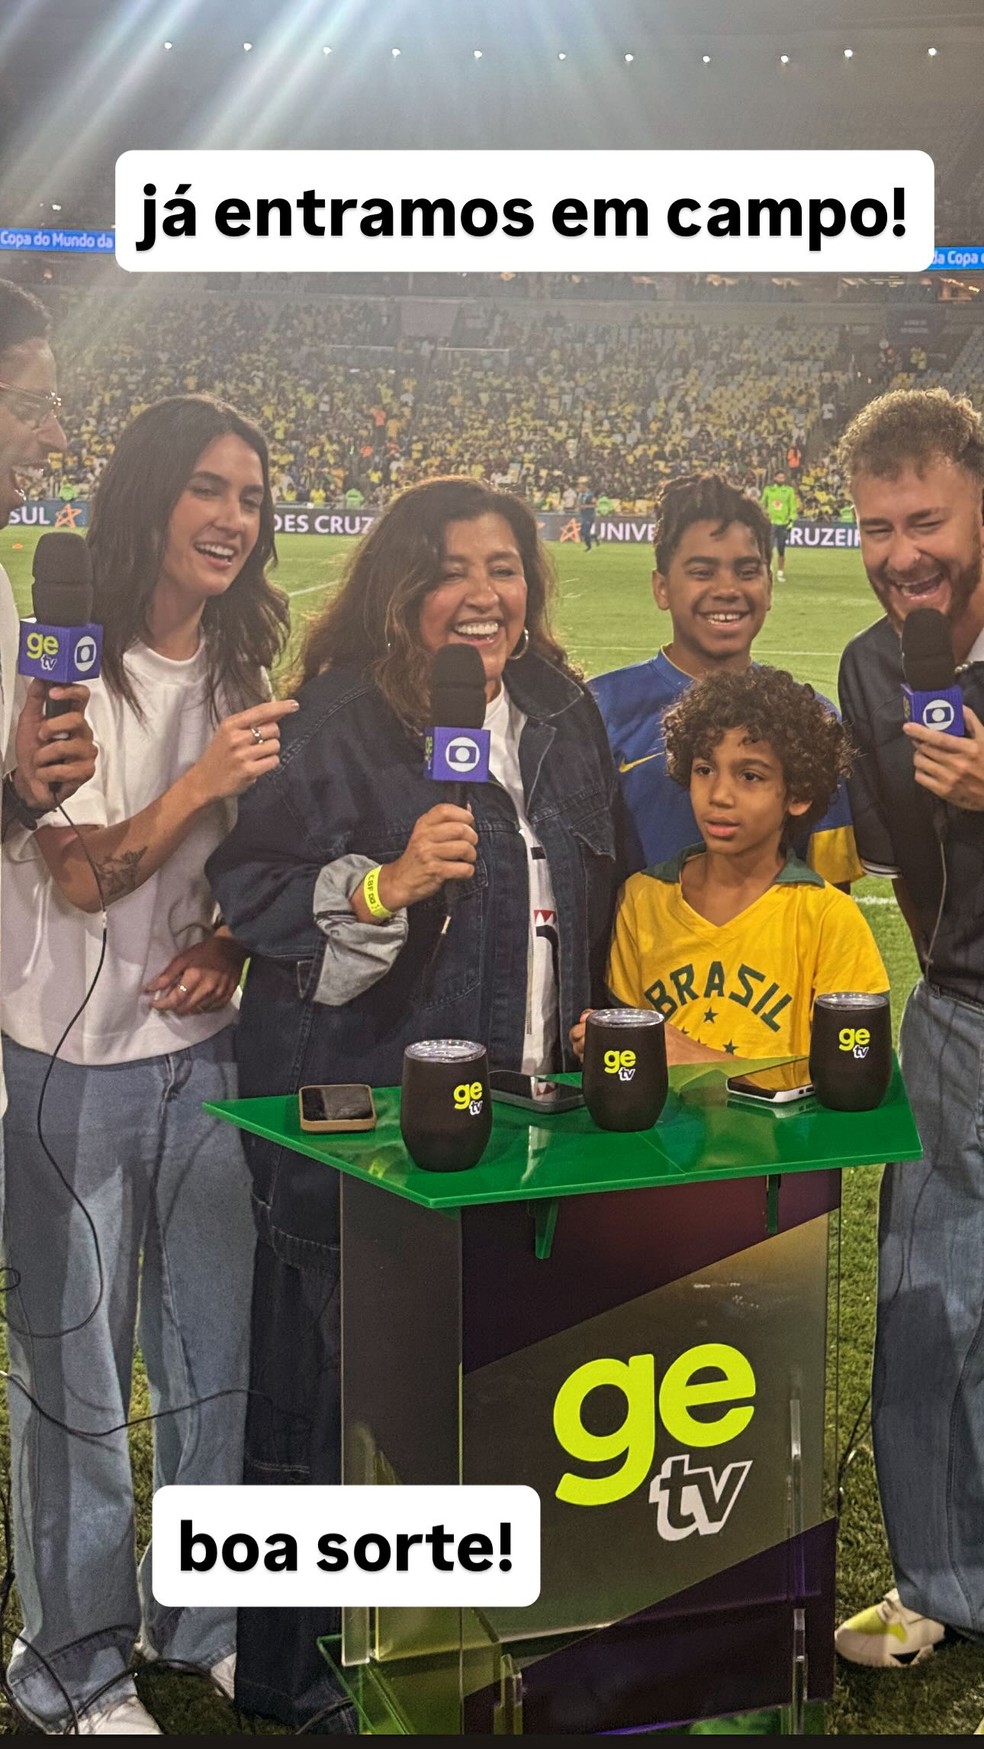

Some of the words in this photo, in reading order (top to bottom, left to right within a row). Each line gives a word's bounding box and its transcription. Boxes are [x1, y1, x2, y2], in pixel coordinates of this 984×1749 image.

[0, 231, 32, 248] Copa
[33, 232, 51, 246] do
[52, 233, 95, 248] Mundo
[97, 234, 114, 248] da
[947, 250, 978, 267] Copa
[8, 506, 50, 525] SUL
[26, 632, 59, 659] ge
[40, 653, 57, 671] tv
[644, 960, 793, 1033] BRASIL
[838, 1028, 871, 1052] ge
[603, 1050, 637, 1074] ge
[853, 1044, 870, 1059] tv
[618, 1066, 636, 1081] tv
[453, 1081, 483, 1110] ge
[469, 1100, 483, 1116] tv
[553, 1343, 756, 1506] ge
[649, 1454, 753, 1542] tv
